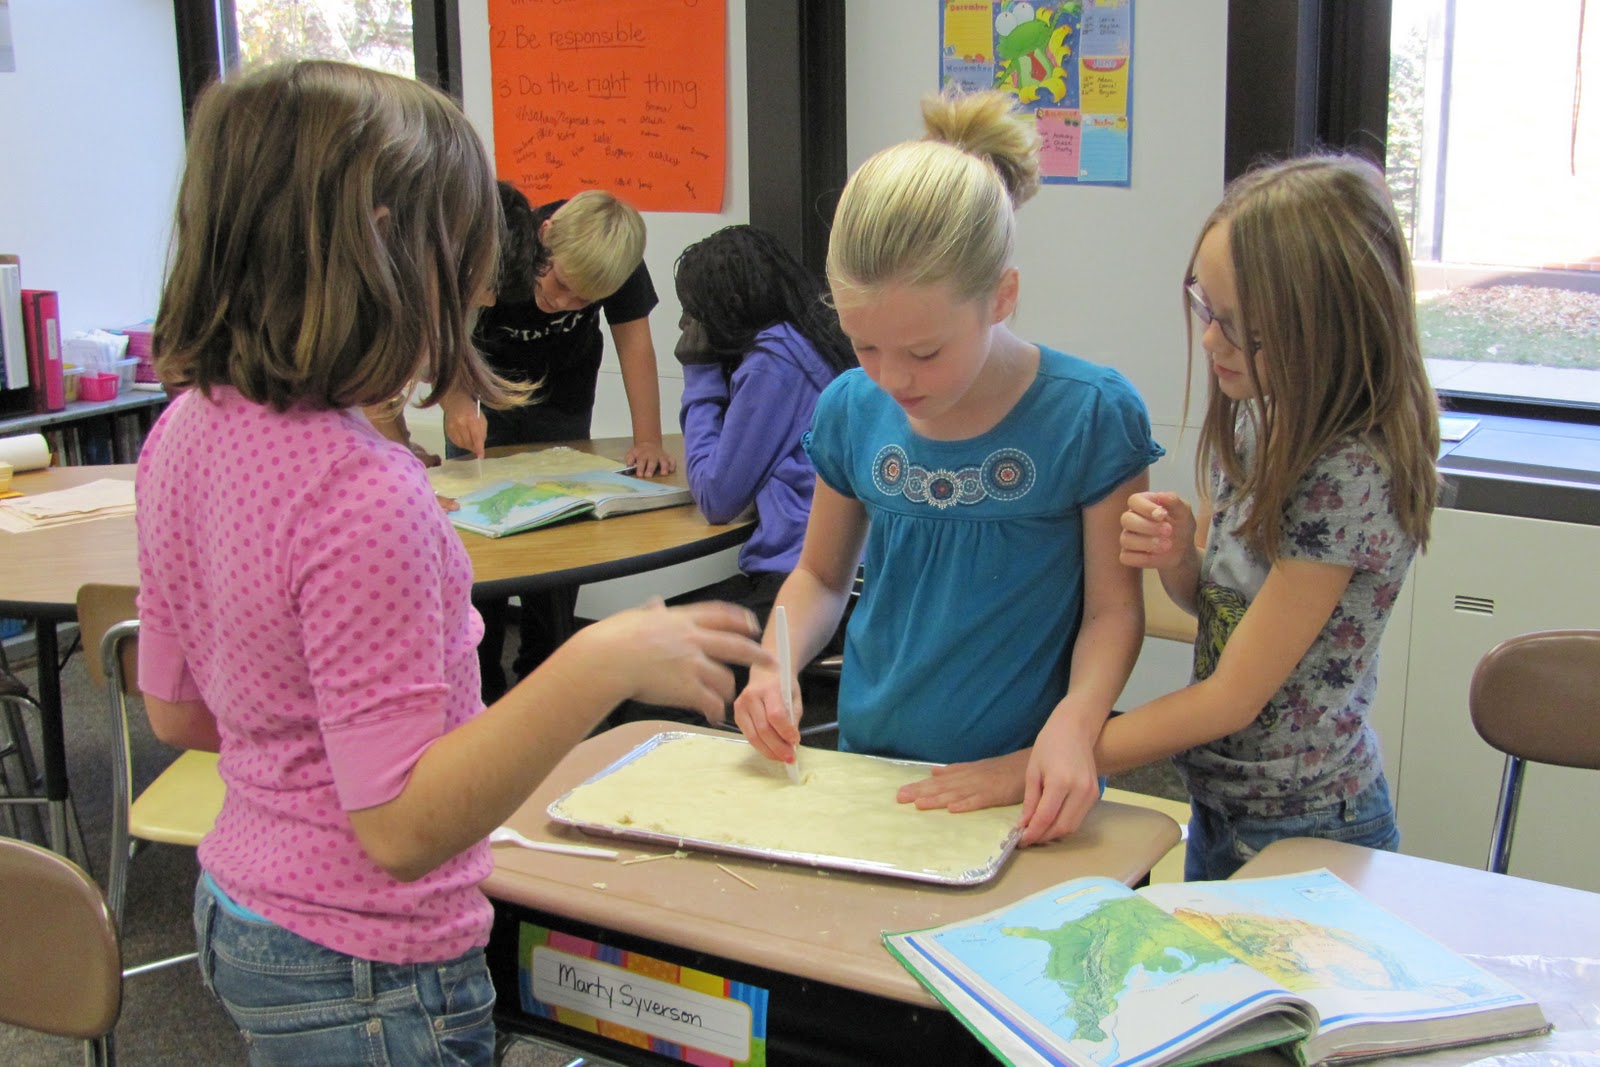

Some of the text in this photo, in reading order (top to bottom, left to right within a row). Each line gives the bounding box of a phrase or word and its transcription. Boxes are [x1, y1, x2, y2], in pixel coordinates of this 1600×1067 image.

[950, 4, 988, 12] December
[516, 24, 541, 49] Be
[550, 20, 646, 53] responsible
[945, 64, 993, 73] November
[519, 74, 542, 96] Do
[547, 71, 579, 95] the
[587, 69, 631, 97] right
[643, 71, 698, 110] thing
[559, 962, 703, 1028] Marty Syverson
